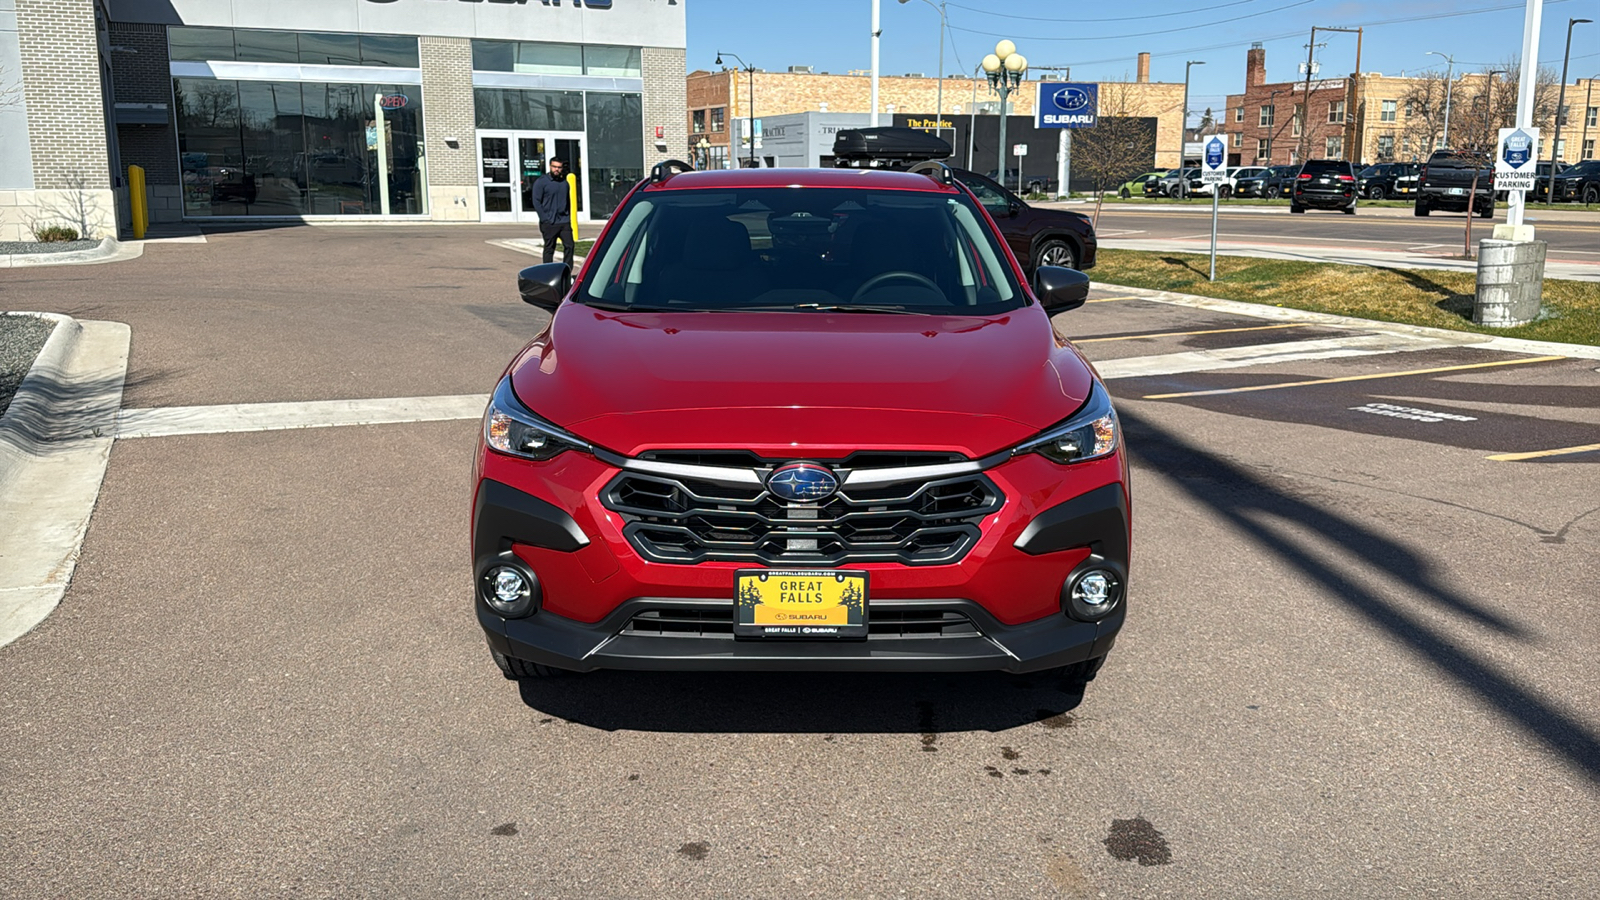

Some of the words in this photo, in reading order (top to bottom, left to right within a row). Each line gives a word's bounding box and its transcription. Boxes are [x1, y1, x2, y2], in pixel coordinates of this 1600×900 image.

[380, 96, 406, 107] OPEN
[907, 118, 922, 127] The
[923, 118, 953, 128] Pratice
[1043, 114, 1094, 124] SUBARU
[780, 581, 823, 591] GREAT
[780, 592, 823, 603] FALLS
